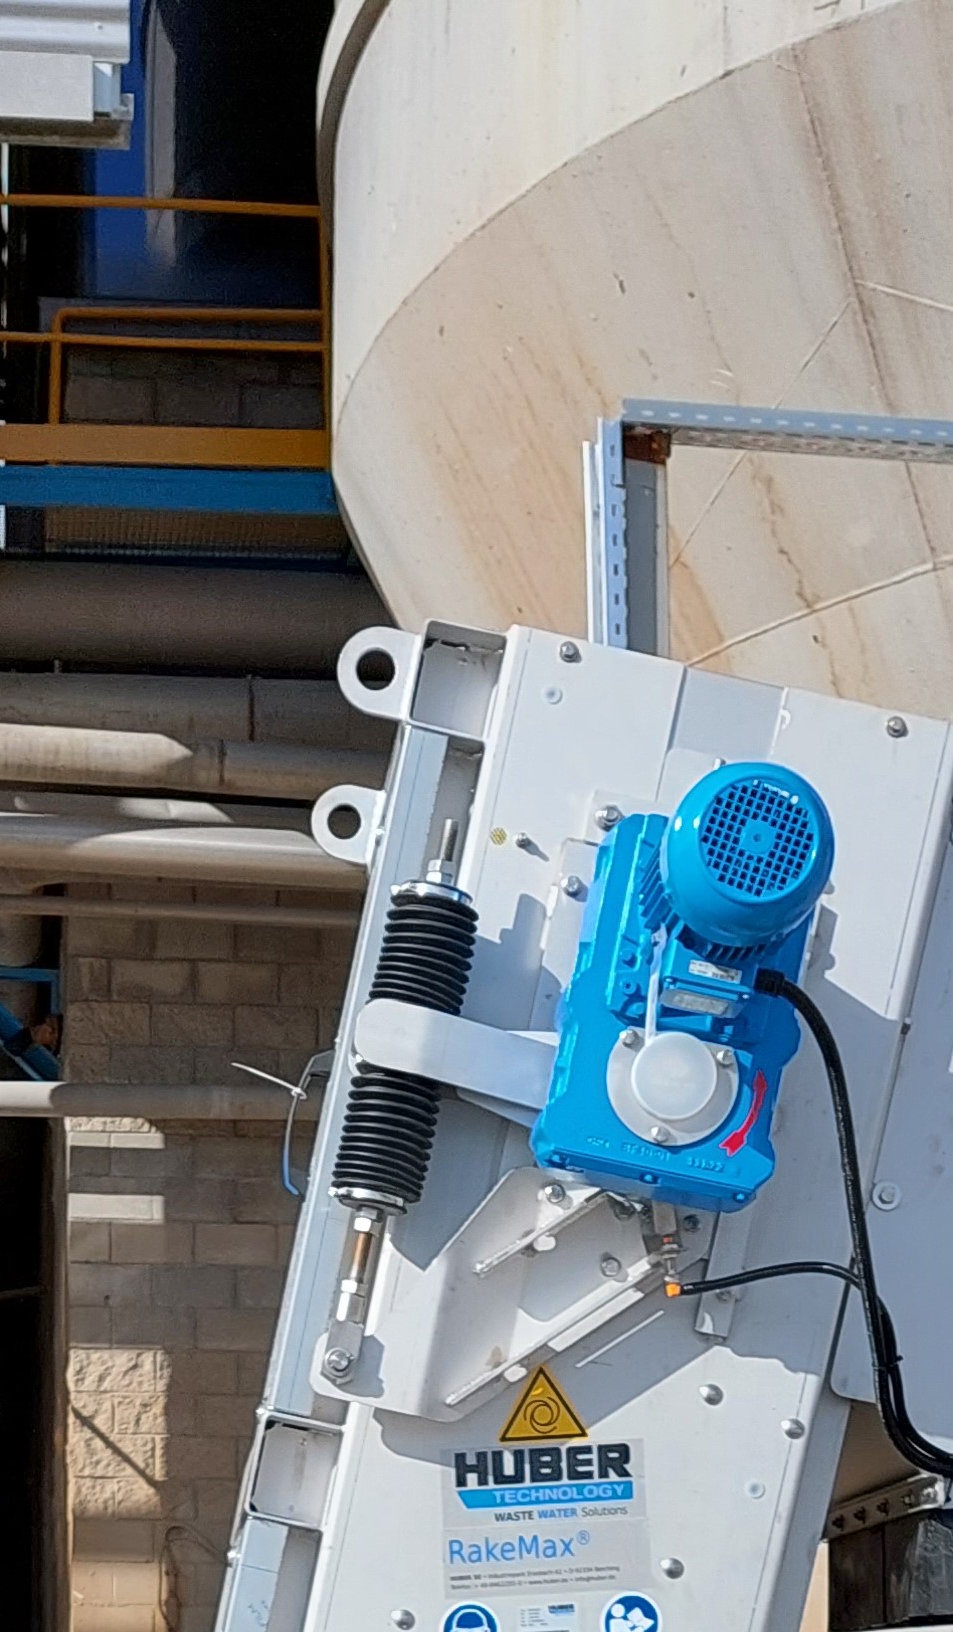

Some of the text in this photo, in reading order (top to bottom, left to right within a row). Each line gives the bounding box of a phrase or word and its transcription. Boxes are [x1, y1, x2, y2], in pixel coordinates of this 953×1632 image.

[454, 1443, 633, 1488] HUBER
[493, 1483, 625, 1504] TECHNOLOGY
[494, 1505, 629, 1522] WASTE WATER Solutions
